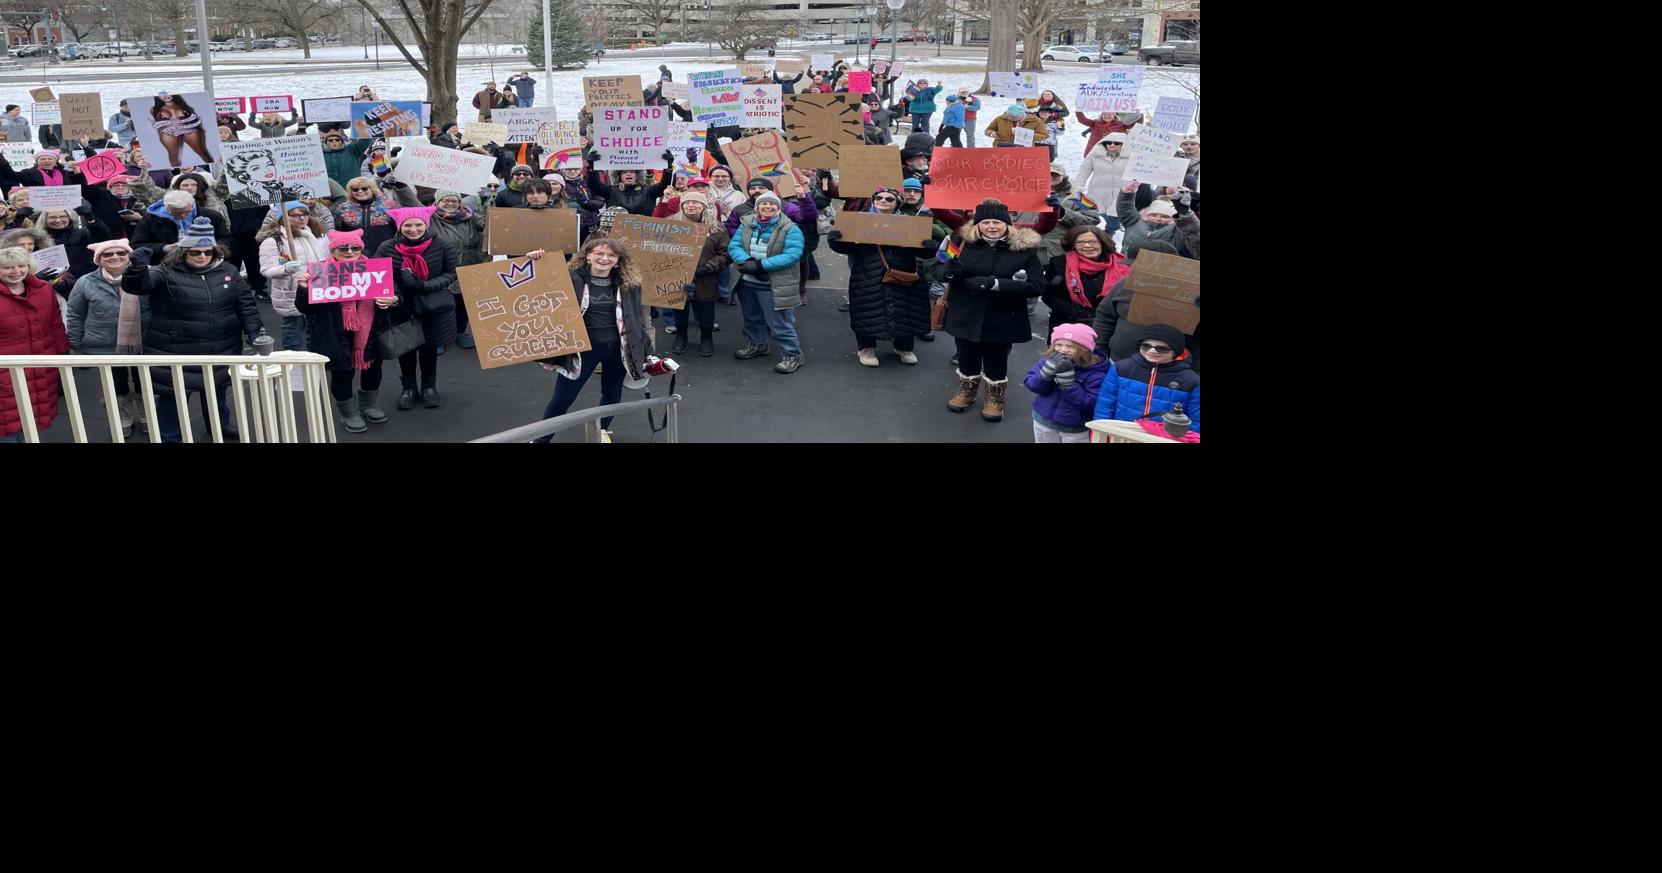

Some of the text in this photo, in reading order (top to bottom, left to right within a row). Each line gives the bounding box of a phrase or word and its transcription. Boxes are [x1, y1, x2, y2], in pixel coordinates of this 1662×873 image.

[689, 70, 724, 80] WHEN
[588, 78, 623, 88] KEEP
[1079, 83, 1123, 91] Indivisible
[711, 92, 740, 104] LAW
[1077, 97, 1111, 111] JOIN
[72, 106, 90, 114] NOT
[364, 102, 393, 120] KEEP
[604, 108, 661, 121] STAND
[1161, 104, 1190, 113] BODY
[68, 119, 92, 127] Going
[366, 109, 417, 138] RESISTING
[1153, 121, 1186, 131] CHOICE
[71, 128, 97, 137] BACK
[1140, 129, 1170, 142] MIND
[274, 136, 312, 146] Woman's
[600, 136, 663, 148] CHOICE
[410, 147, 443, 160] MIND
[427, 161, 458, 175] OWN
[935, 155, 1046, 171] OUR BODIES
[279, 174, 297, 182] Oval
[934, 175, 1049, 192] OUR CHOICE
[623, 217, 691, 235] FEMINISM
[311, 261, 367, 275] BANS
[311, 270, 387, 288] OFF MY
[311, 284, 370, 301] BODY
[656, 277, 688, 295] NOW
[476, 290, 569, 321] I GOT
[487, 329, 585, 361] QUEEN.
